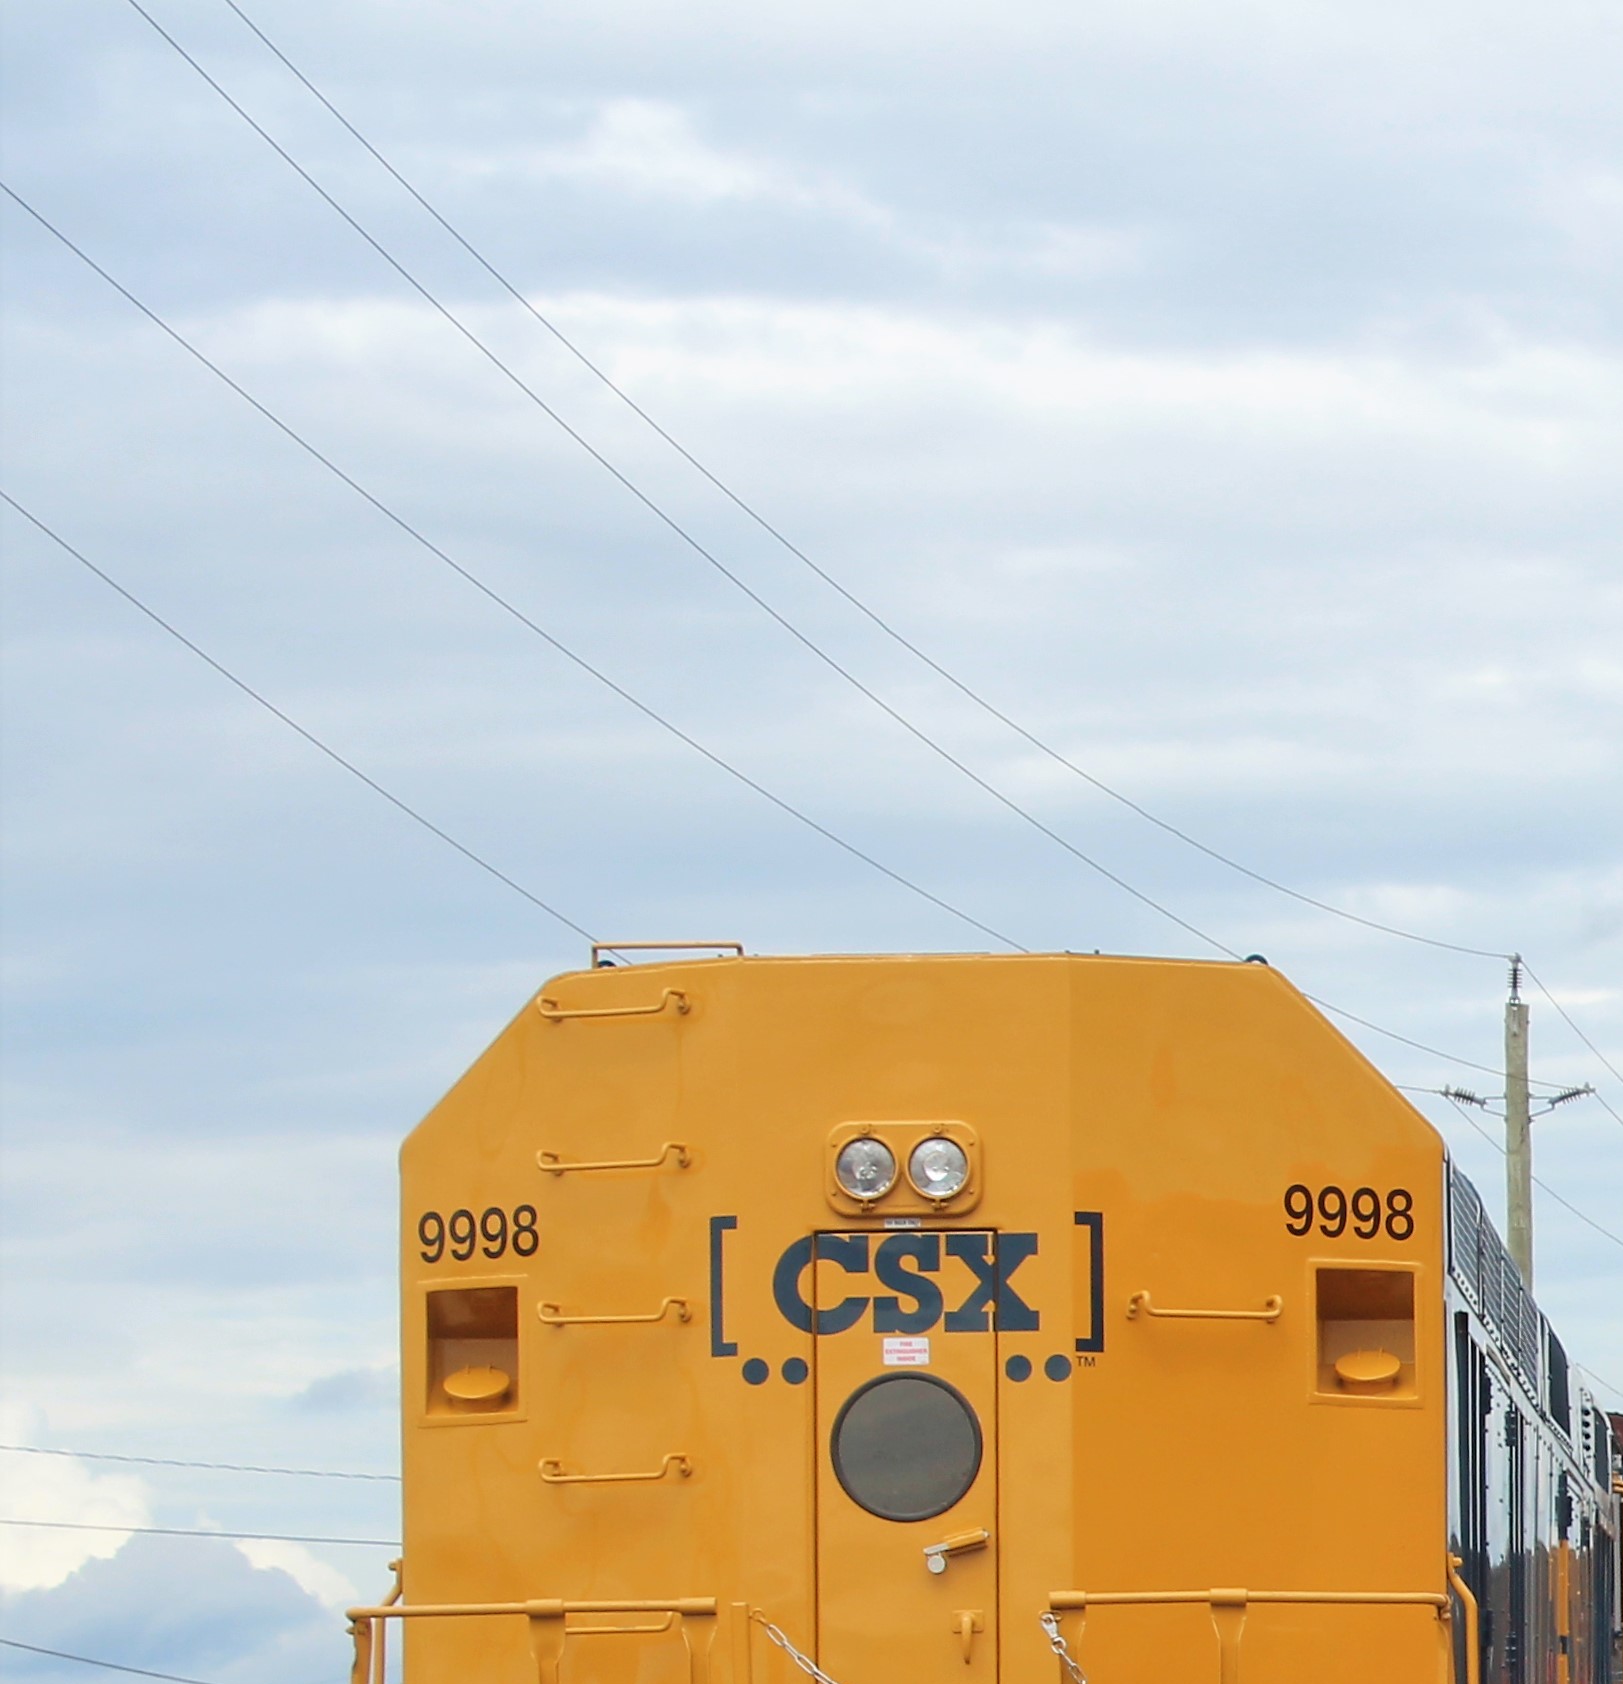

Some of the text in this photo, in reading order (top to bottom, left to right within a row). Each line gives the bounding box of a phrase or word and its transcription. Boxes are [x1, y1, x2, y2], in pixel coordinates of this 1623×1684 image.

[418, 1204, 540, 1264] 9998
[1283, 1184, 1415, 1241] 9998
[772, 1232, 1041, 1336] CSX
[1076, 1355, 1096, 1367] TM
